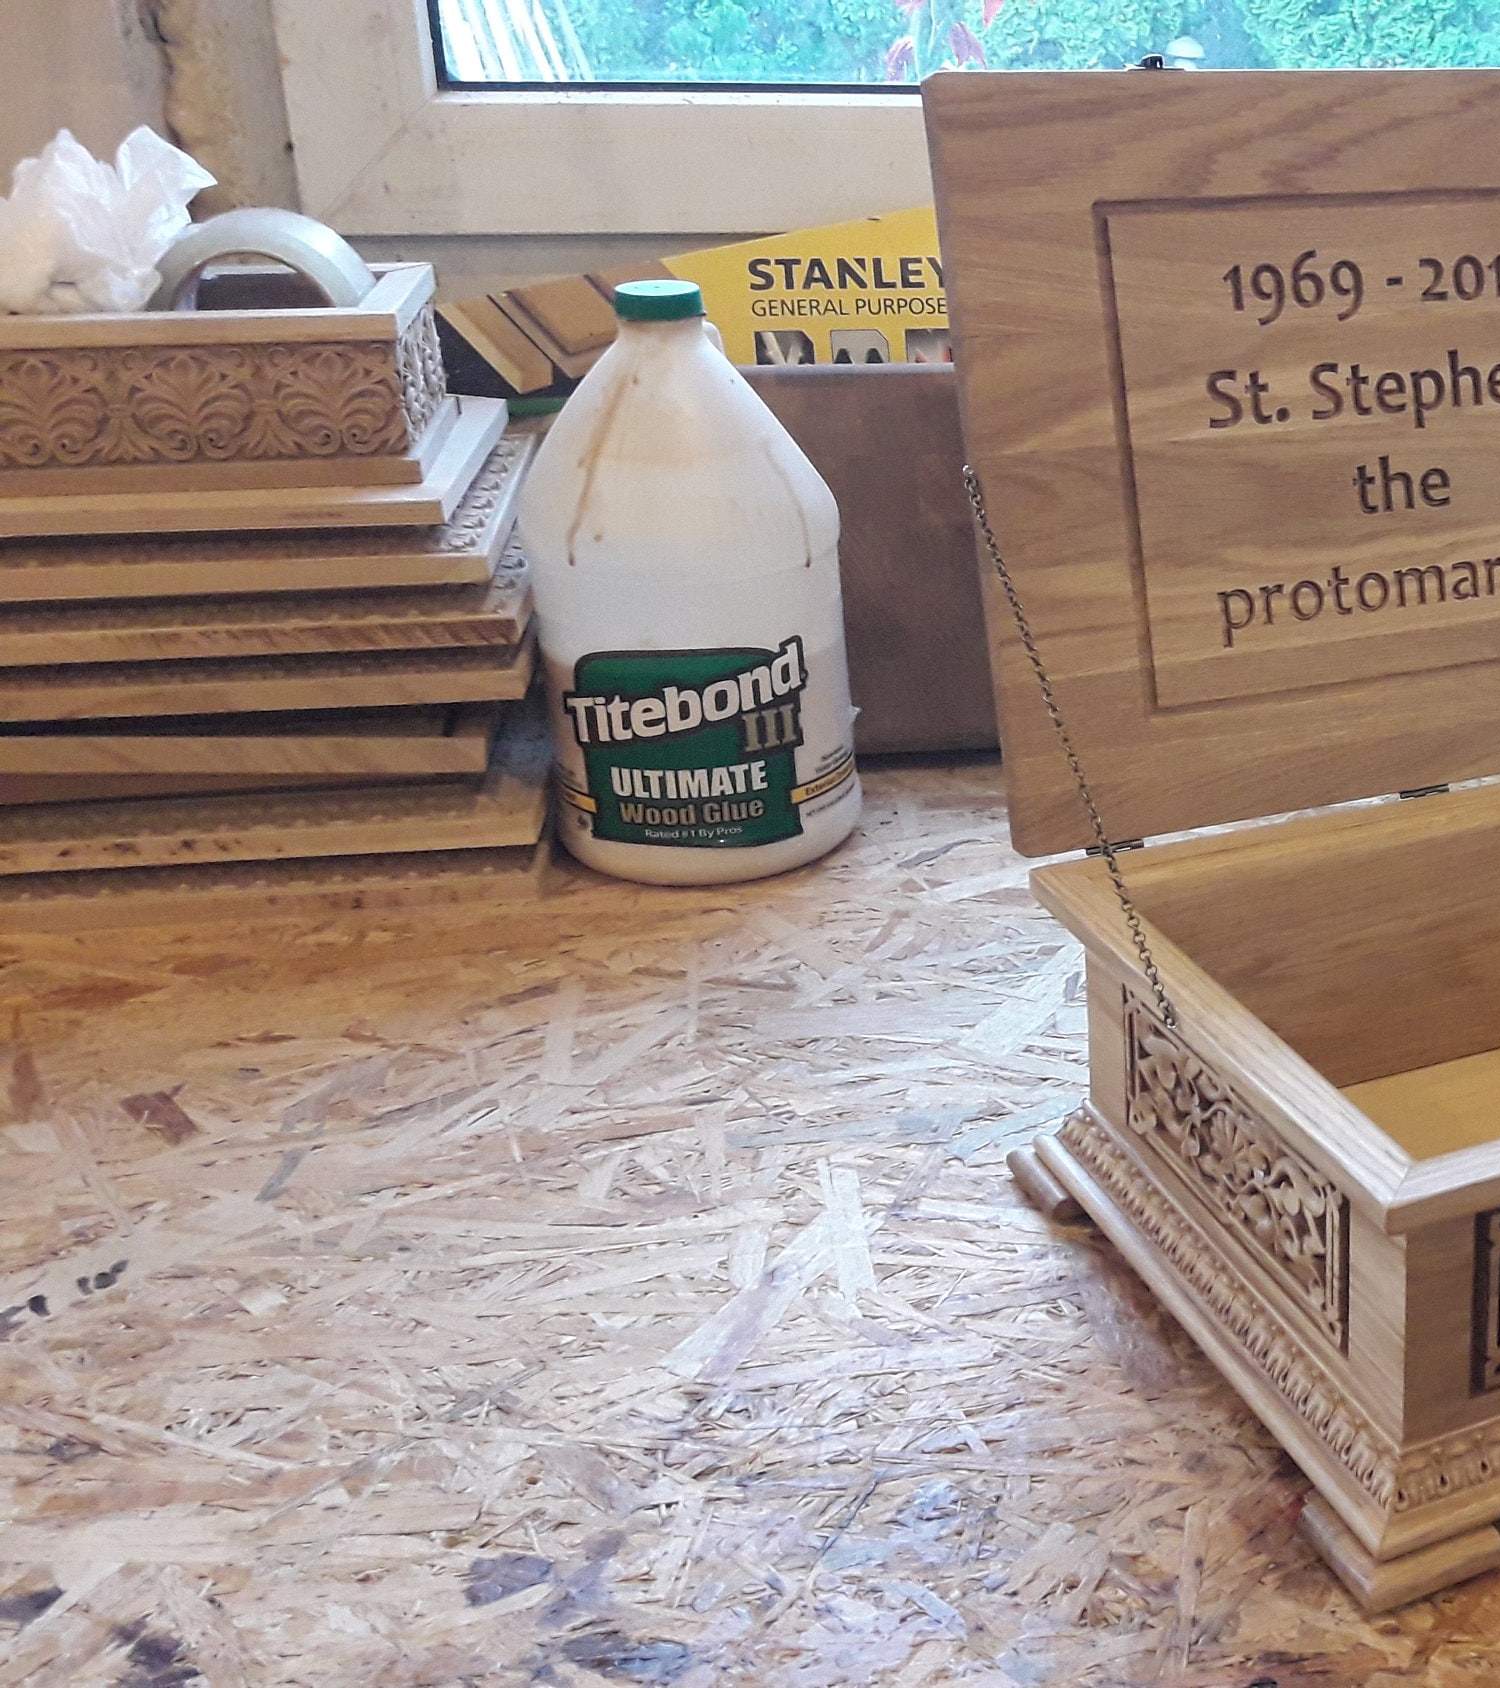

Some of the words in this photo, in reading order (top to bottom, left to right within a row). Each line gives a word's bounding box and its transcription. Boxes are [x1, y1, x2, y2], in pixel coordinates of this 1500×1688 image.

[751, 298, 850, 317] GENERAL
[855, 296, 948, 316] PURPOSE
[1221, 248, 1365, 326] 1969
[1205, 368, 1291, 429] St.
[1352, 455, 1452, 514] the
[566, 641, 803, 744] Titebond
[742, 703, 797, 752] III
[610, 759, 769, 799] ULTIMATE
[619, 801, 698, 826] Wood
[702, 799, 765, 825] Glue
[644, 828, 679, 839] Rated
[699, 828, 715, 839] By
[717, 826, 743, 836] Pros
